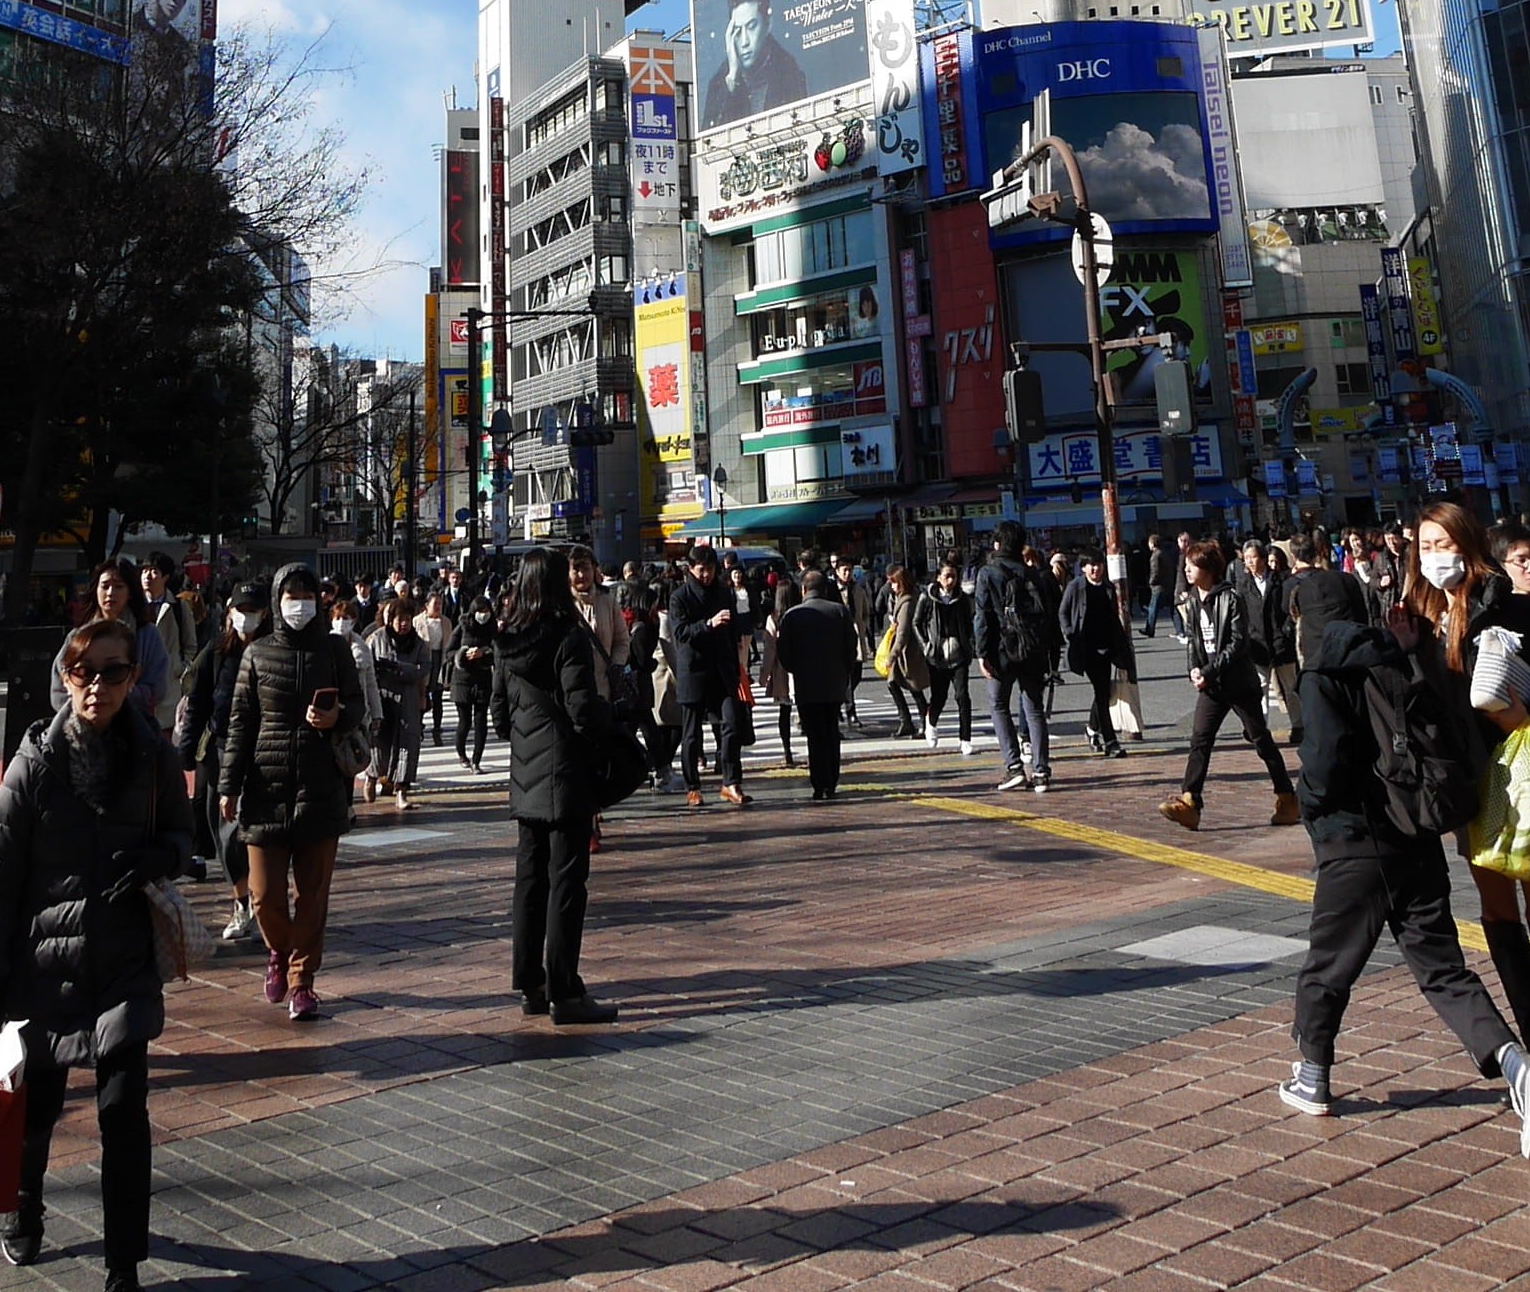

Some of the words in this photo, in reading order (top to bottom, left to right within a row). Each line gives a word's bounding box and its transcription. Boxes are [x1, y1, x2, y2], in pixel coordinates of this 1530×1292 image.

[984, 38, 1007, 55] DHC
[1007, 30, 1053, 49] Channel
[872, 9, 920, 163] もんじゃ
[1057, 57, 1111, 83] DHC
[635, 143, 676, 161] 夜11時
[642, 160, 669, 175] まで
[653, 182, 677, 198] 地下
[1213, 146, 1233, 216] neon
[1109, 251, 1183, 284] MM
[1099, 285, 1155, 317] FX
[943, 302, 996, 404] クスリ
[648, 364, 680, 409] 薬
